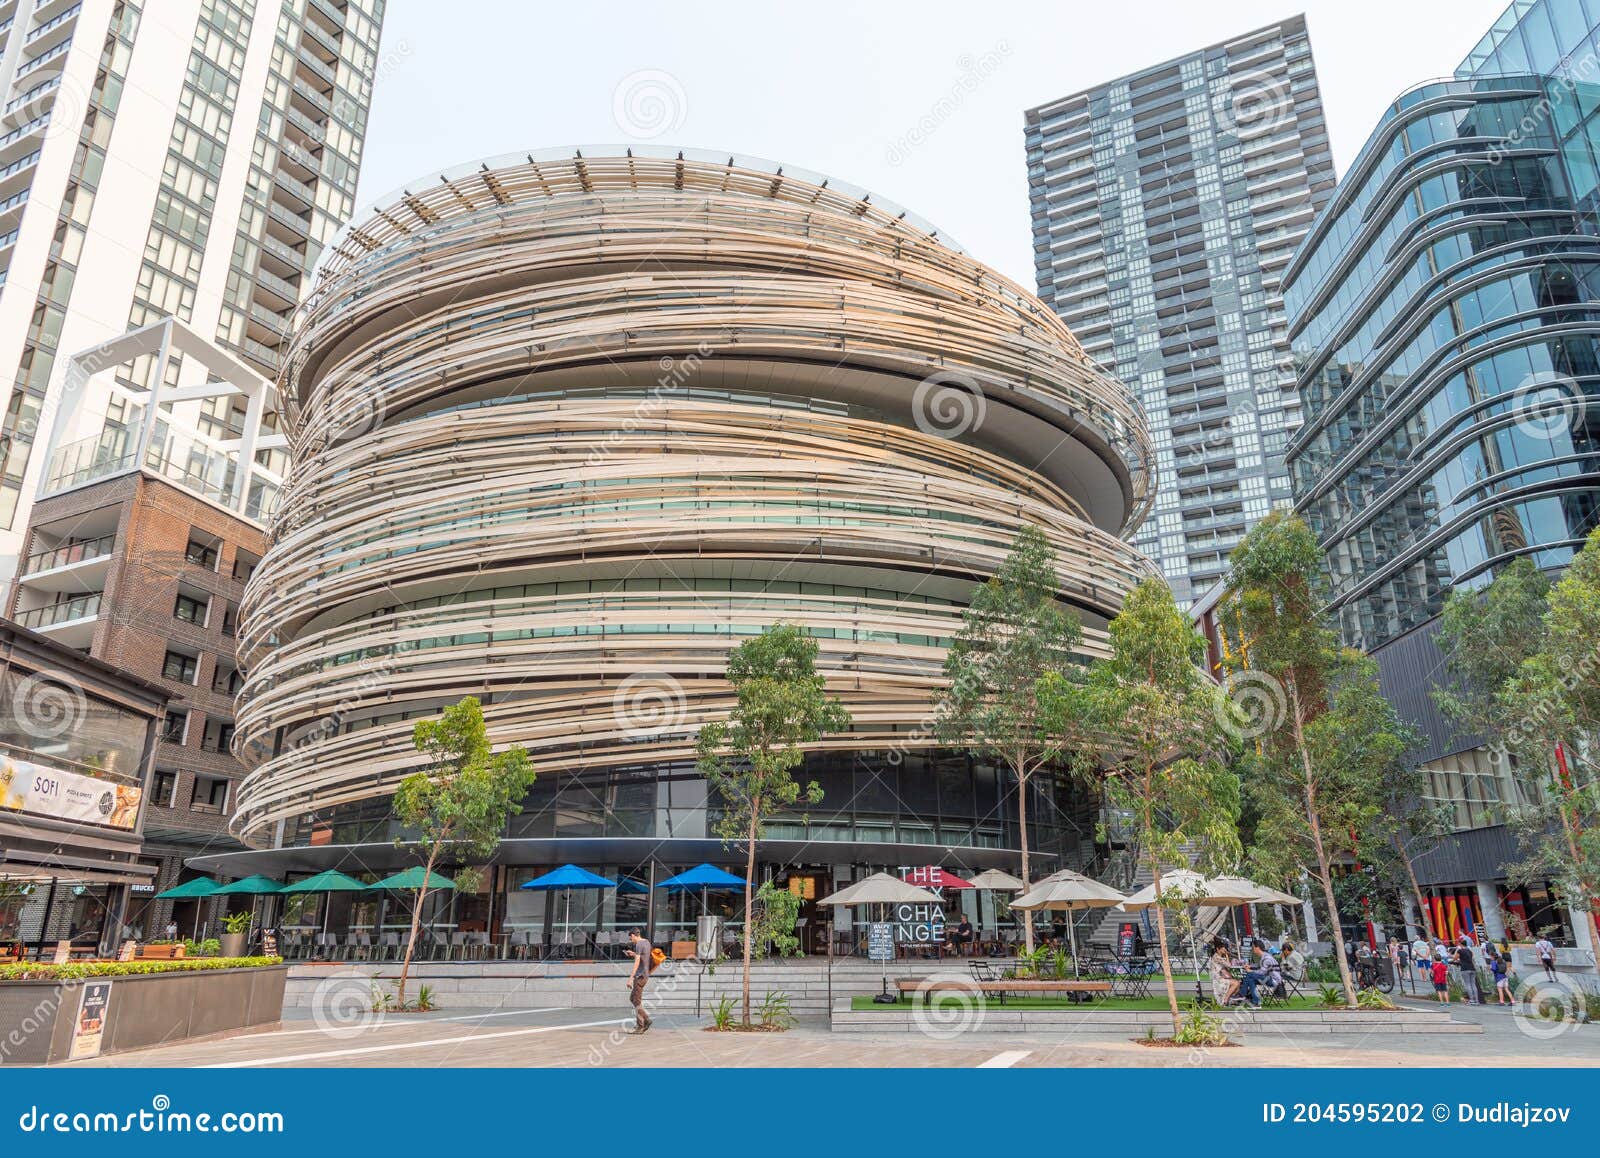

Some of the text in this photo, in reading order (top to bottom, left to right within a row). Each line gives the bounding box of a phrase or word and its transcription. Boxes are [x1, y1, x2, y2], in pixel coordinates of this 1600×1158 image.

[35, 776, 59, 796] SOFI
[898, 866, 943, 882] THE
[898, 904, 946, 921] CHA
[899, 924, 946, 941] NGE
